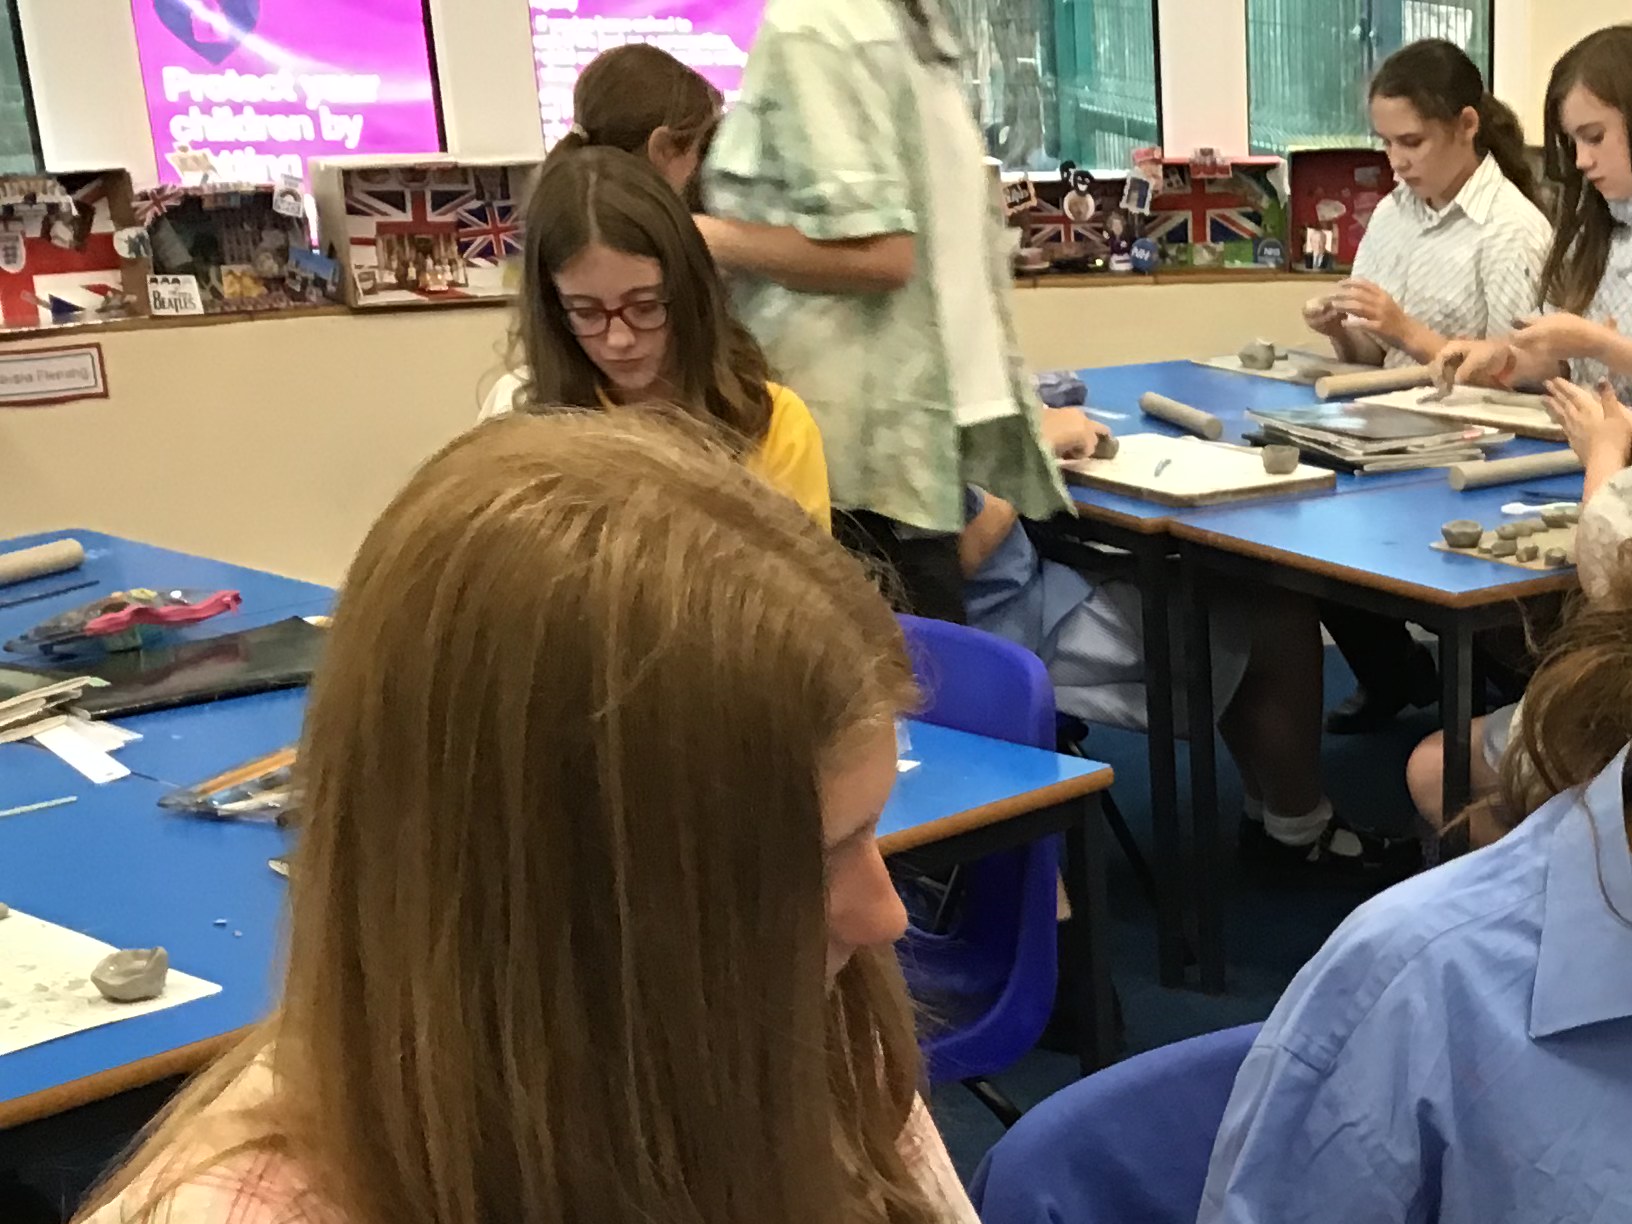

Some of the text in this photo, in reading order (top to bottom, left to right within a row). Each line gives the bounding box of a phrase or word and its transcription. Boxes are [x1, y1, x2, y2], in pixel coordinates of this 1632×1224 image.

[162, 66, 298, 102] Protect
[169, 105, 364, 149] children by
